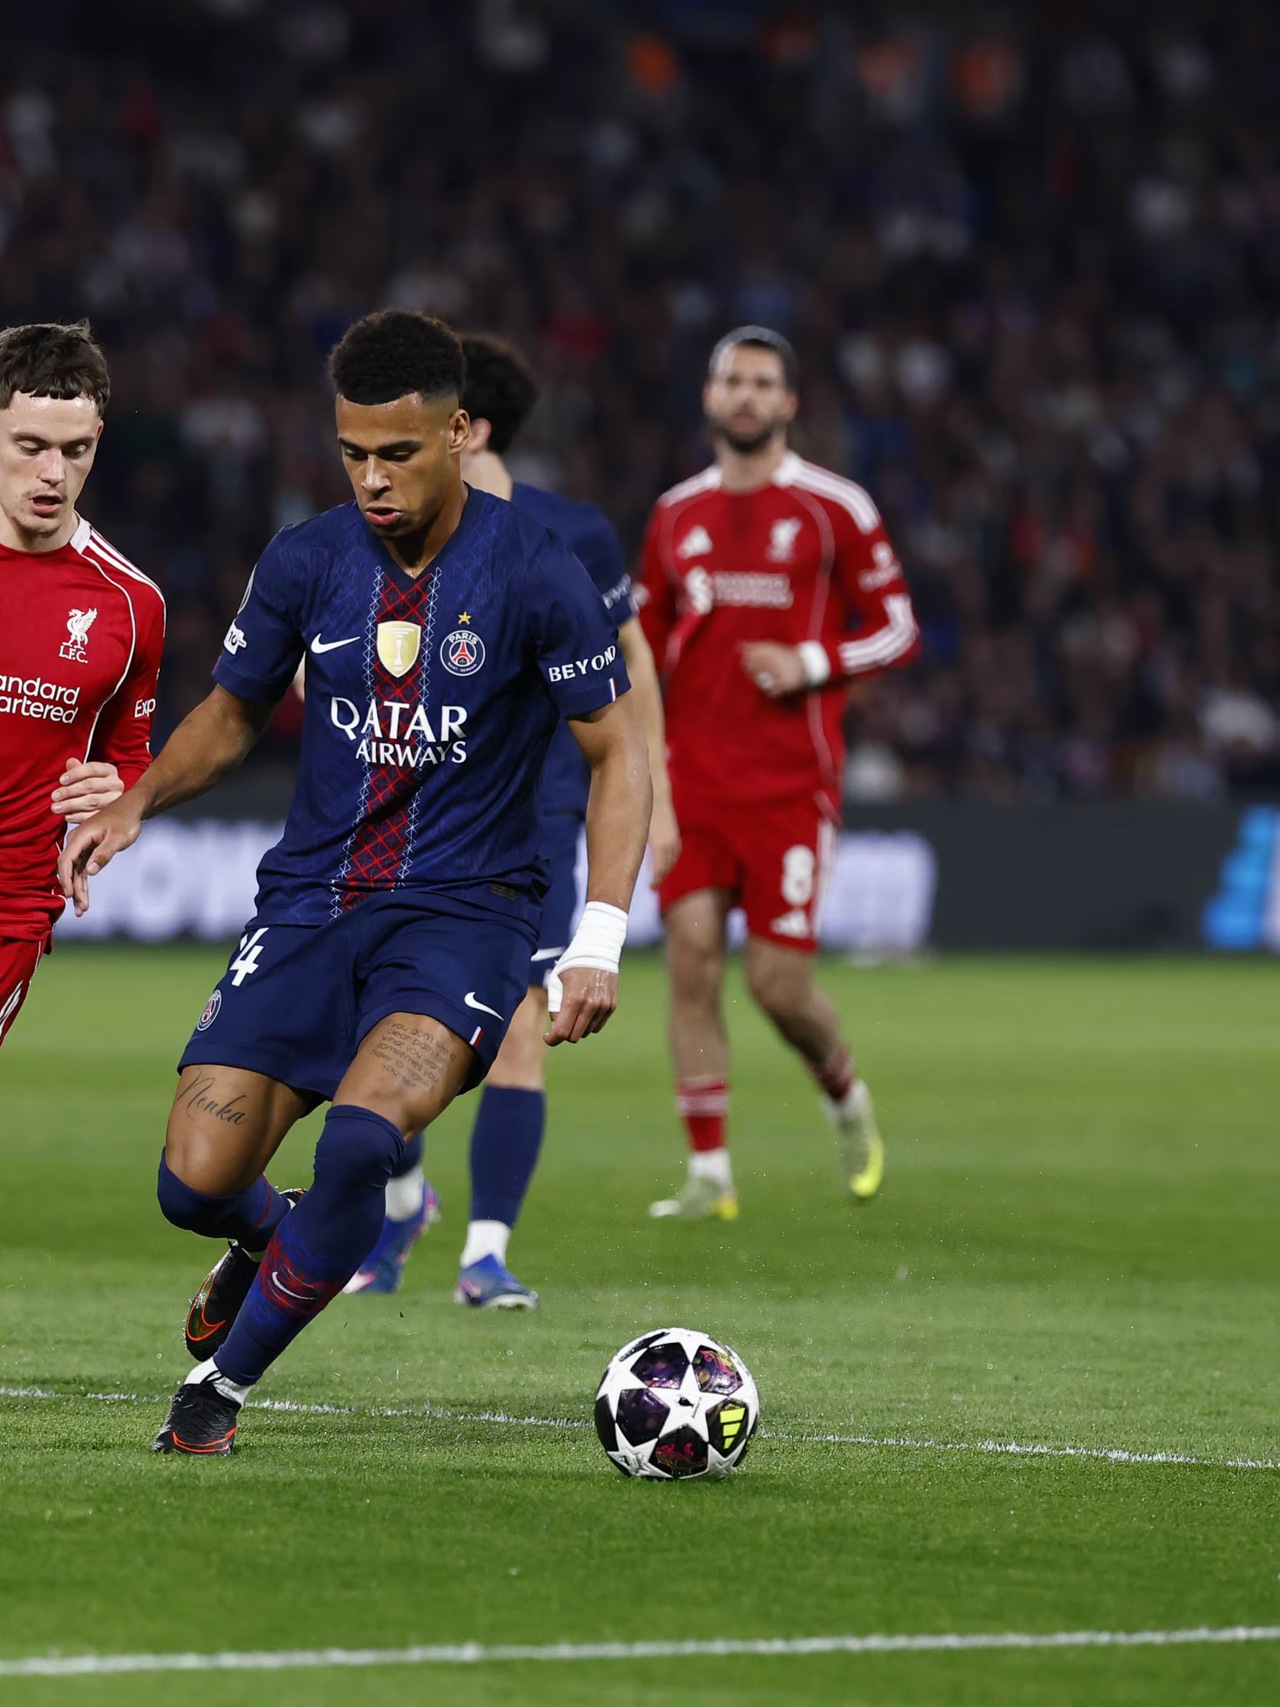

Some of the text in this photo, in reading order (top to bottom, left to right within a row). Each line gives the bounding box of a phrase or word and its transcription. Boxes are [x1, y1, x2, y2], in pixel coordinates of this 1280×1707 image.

[448, 632, 479, 645] PARIS
[548, 645, 616, 682] BEYOND
[331, 697, 468, 742] QATAR
[355, 739, 467, 768] AIRWAYS
[781, 845, 816, 905] 8
[229, 927, 269, 987] 4
